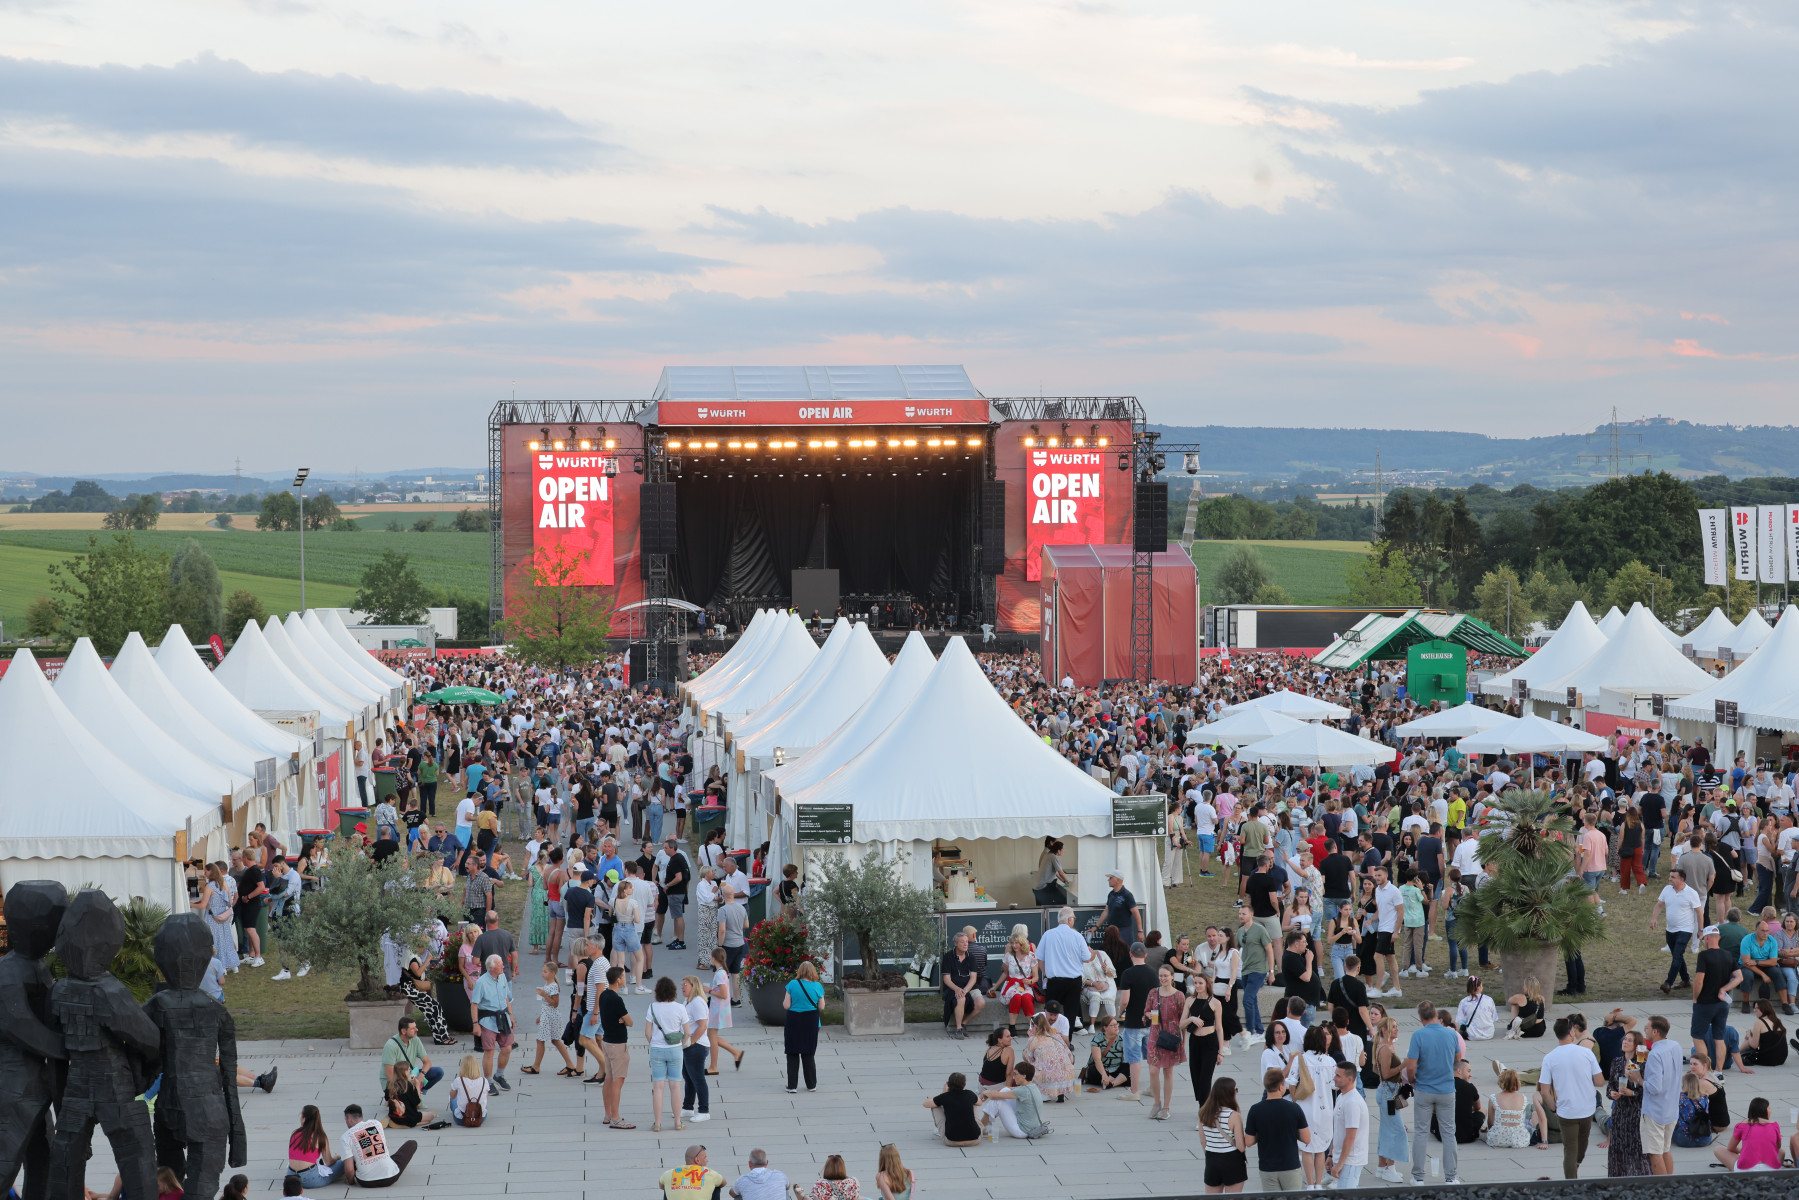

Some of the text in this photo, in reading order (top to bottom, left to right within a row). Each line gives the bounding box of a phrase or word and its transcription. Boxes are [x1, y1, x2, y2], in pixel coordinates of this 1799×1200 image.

[710, 409, 746, 418] WÜRTH
[798, 407, 853, 419] OPEN AIR
[917, 408, 953, 416] WÜRTH
[1050, 453, 1100, 465] WÜRTH
[538, 476, 608, 502] OPEN
[1032, 473, 1100, 498] OPEN
[538, 503, 586, 528] AIR
[1032, 499, 1078, 524] AIR
